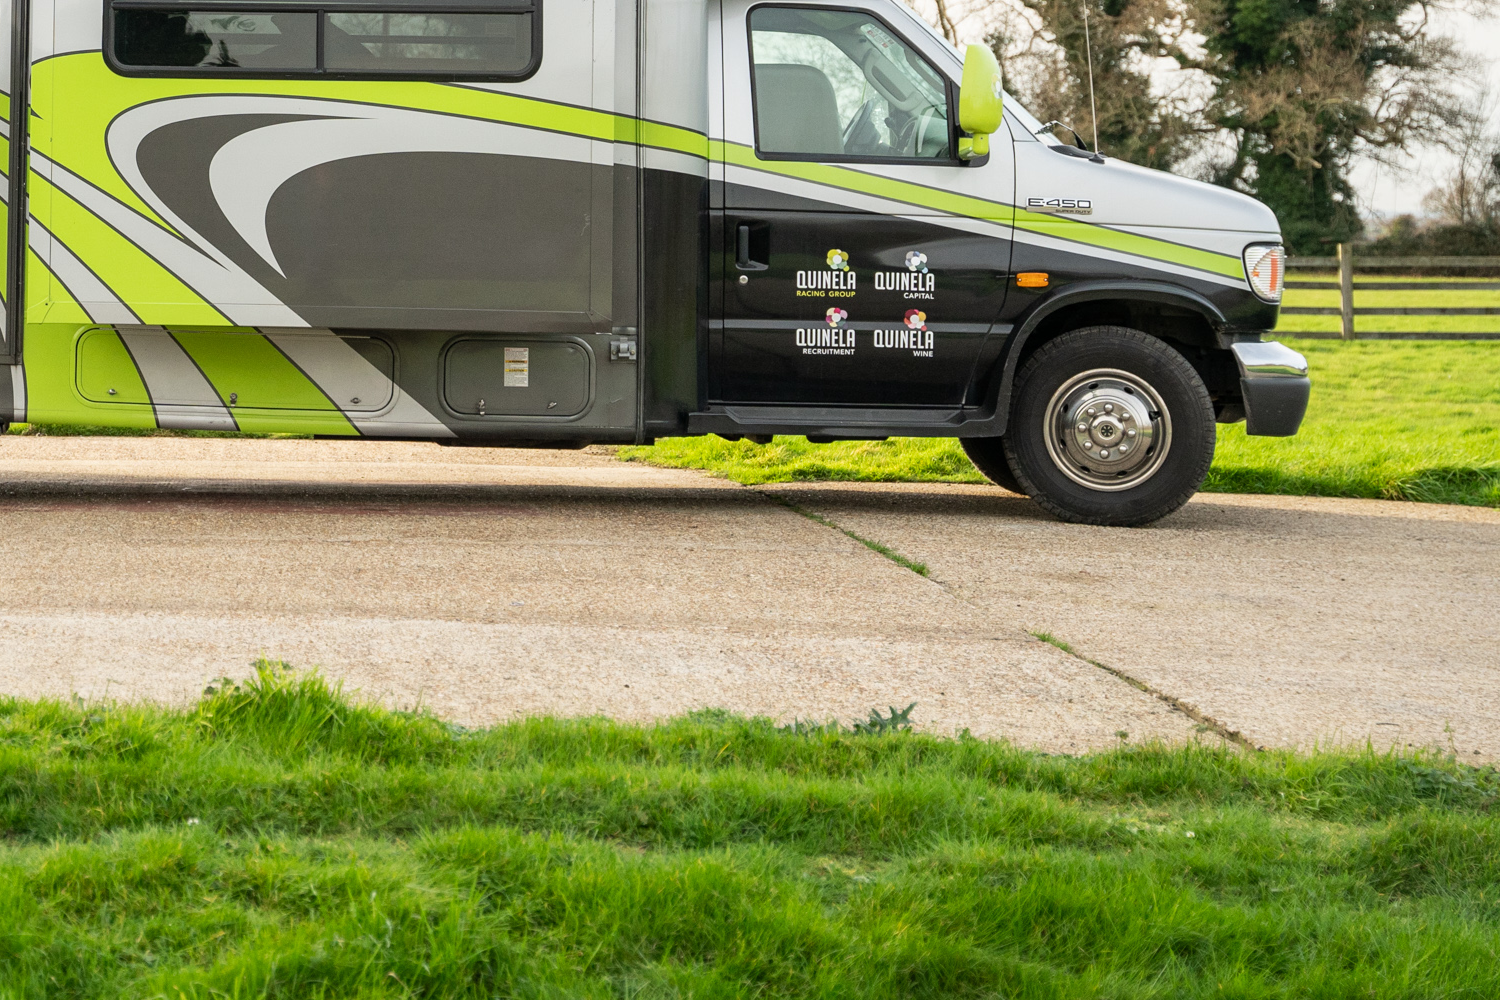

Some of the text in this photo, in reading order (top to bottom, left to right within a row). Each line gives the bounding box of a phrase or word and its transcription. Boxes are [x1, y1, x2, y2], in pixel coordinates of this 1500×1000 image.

[796, 270, 856, 290] QUINELA
[874, 272, 935, 292] QUINELA
[796, 328, 856, 347] QUINELA
[874, 330, 934, 350] QUINELA
